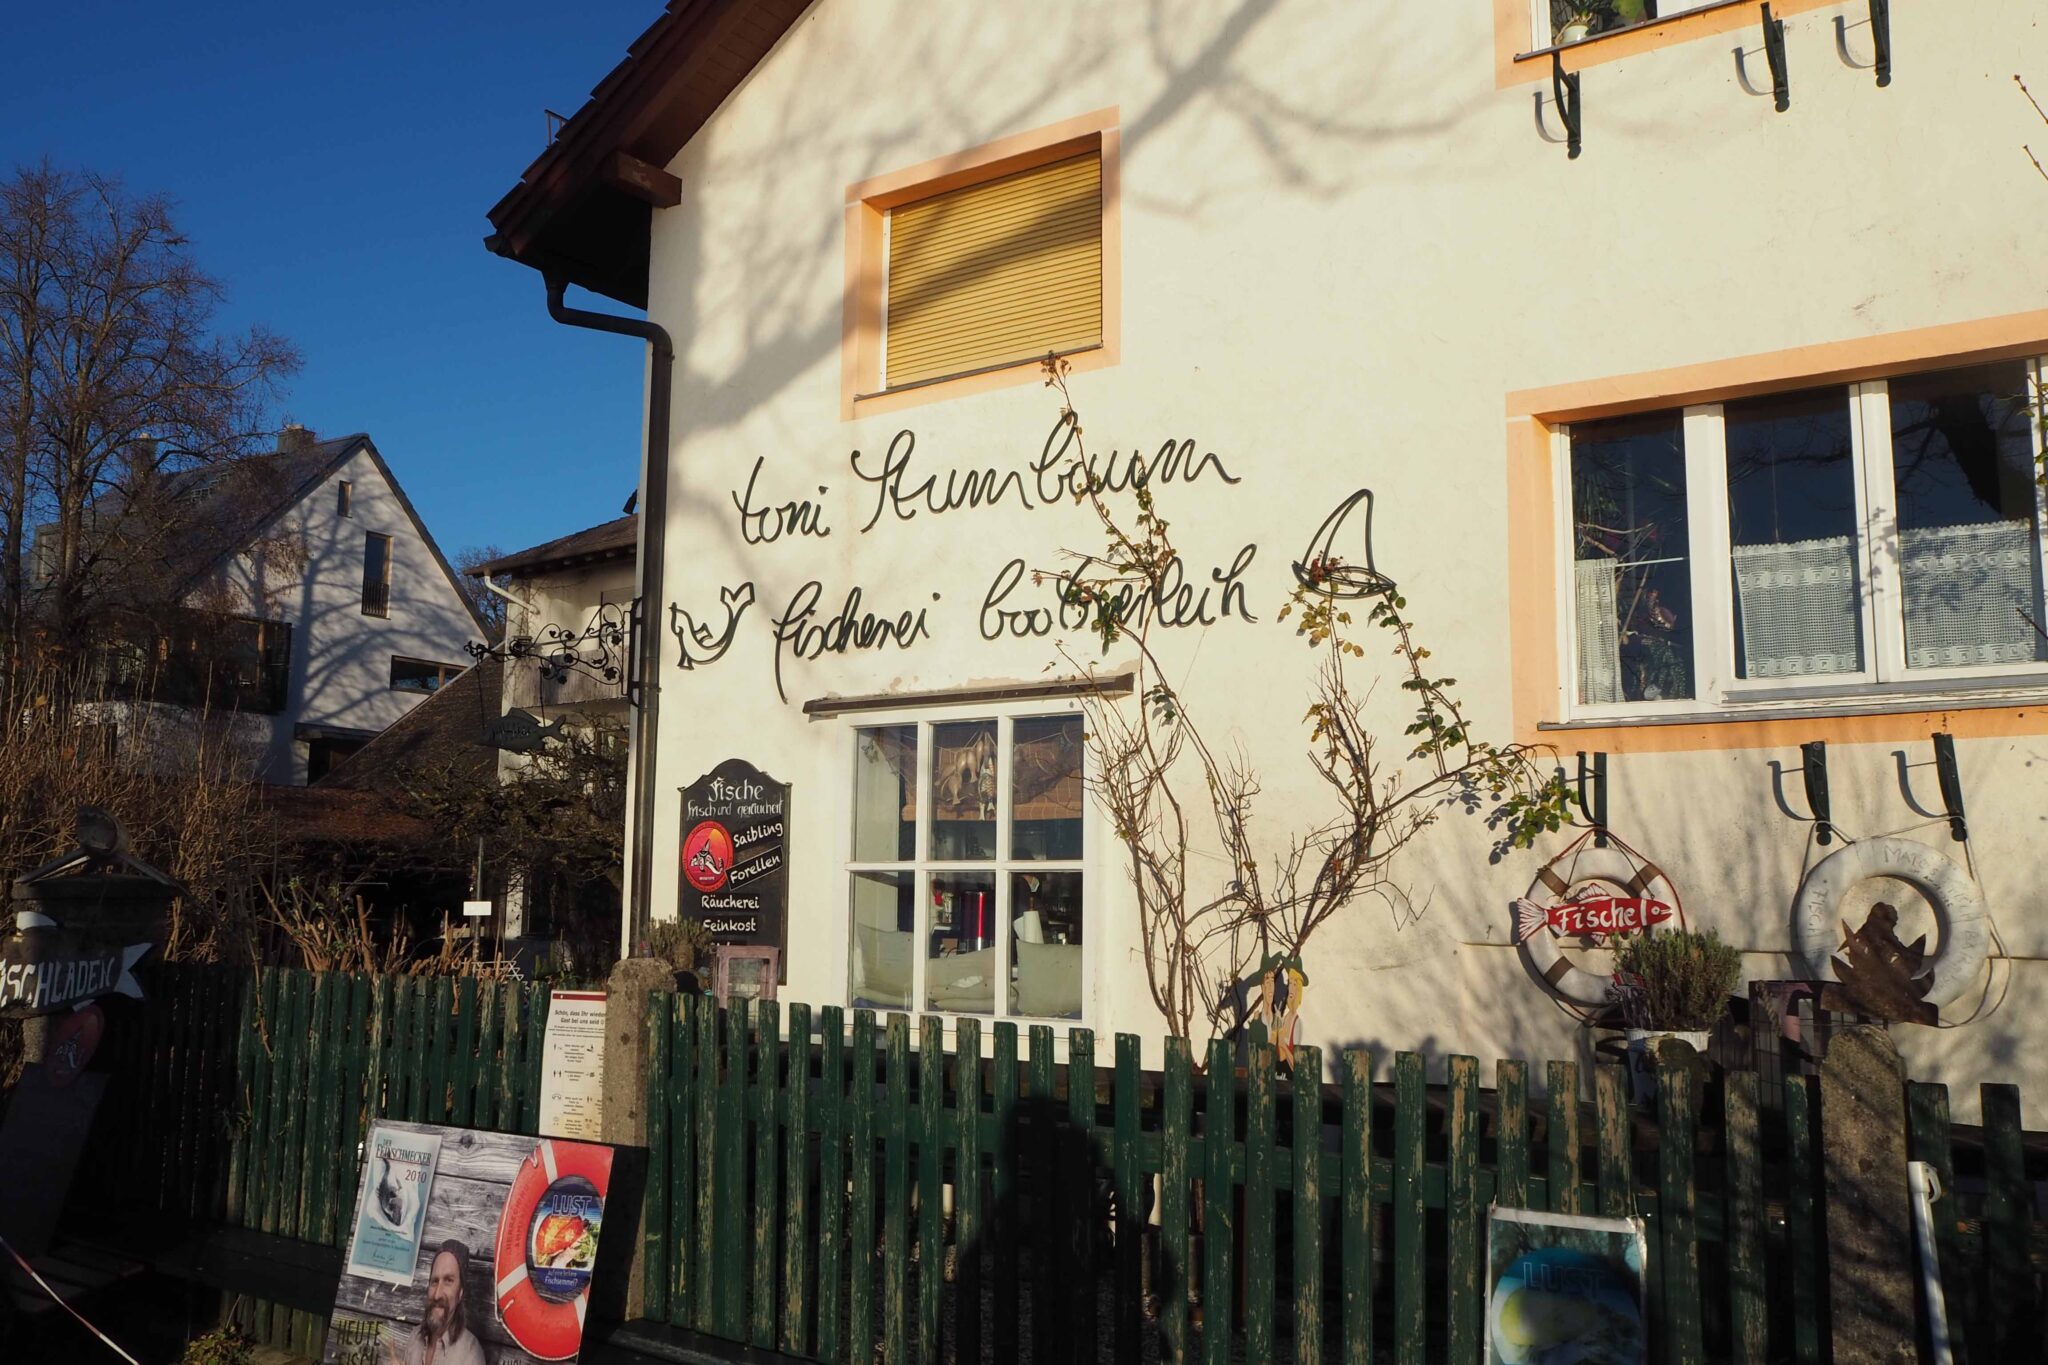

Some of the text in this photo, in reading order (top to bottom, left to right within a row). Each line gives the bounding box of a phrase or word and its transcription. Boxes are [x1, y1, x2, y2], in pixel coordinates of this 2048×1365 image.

[708, 777, 764, 802] Fische
[733, 823, 783, 847] Saibling
[730, 855, 781, 884] Forellen
[702, 894, 760, 909] Räucherei
[703, 917, 757, 932] Feinkost
[405, 1169, 427, 1184] 2010
[552, 1194, 593, 1217] LUST
[337, 1319, 383, 1346] HEUTE
